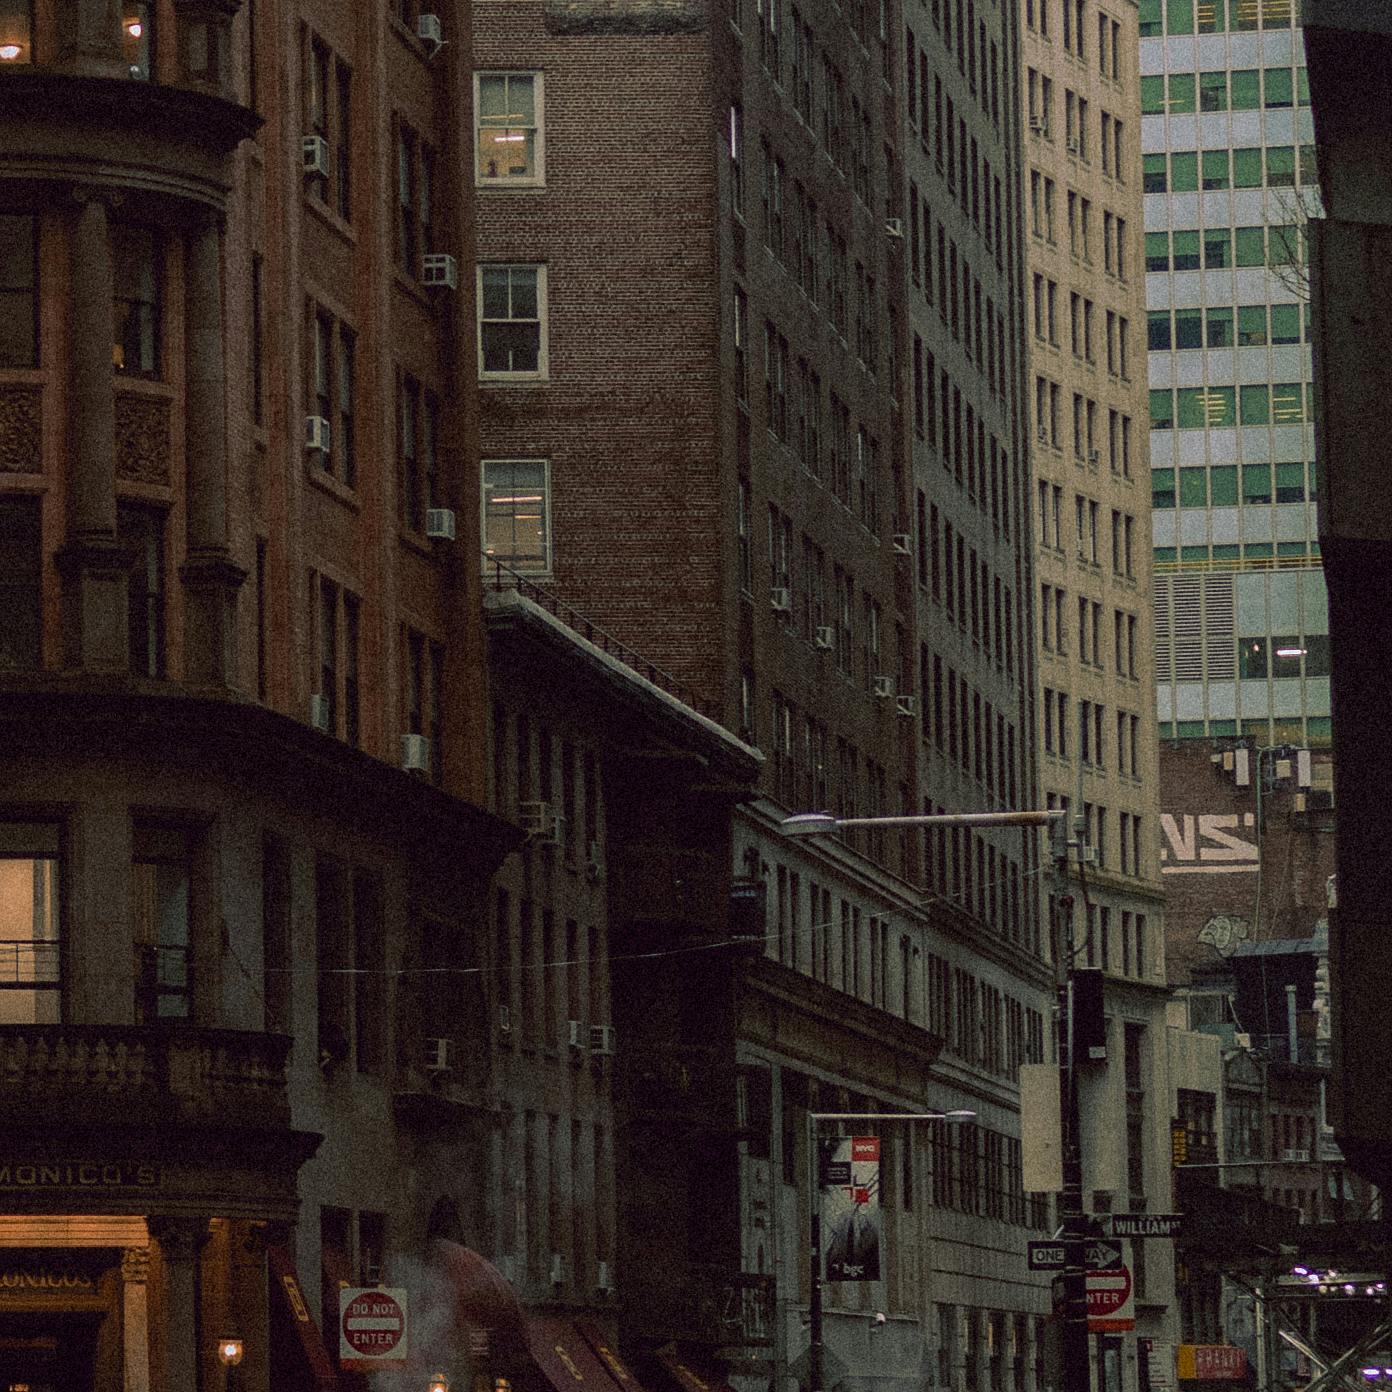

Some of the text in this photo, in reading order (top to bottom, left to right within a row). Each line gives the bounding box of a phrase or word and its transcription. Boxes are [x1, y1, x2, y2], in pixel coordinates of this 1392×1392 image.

[1115, 1221, 1170, 1234] WILLIAM
[1036, 1250, 1064, 1262] ONE
[1086, 1292, 1120, 1304] NTER
[352, 1303, 395, 1314] DO NOT
[353, 1333, 393, 1344] ENTER
